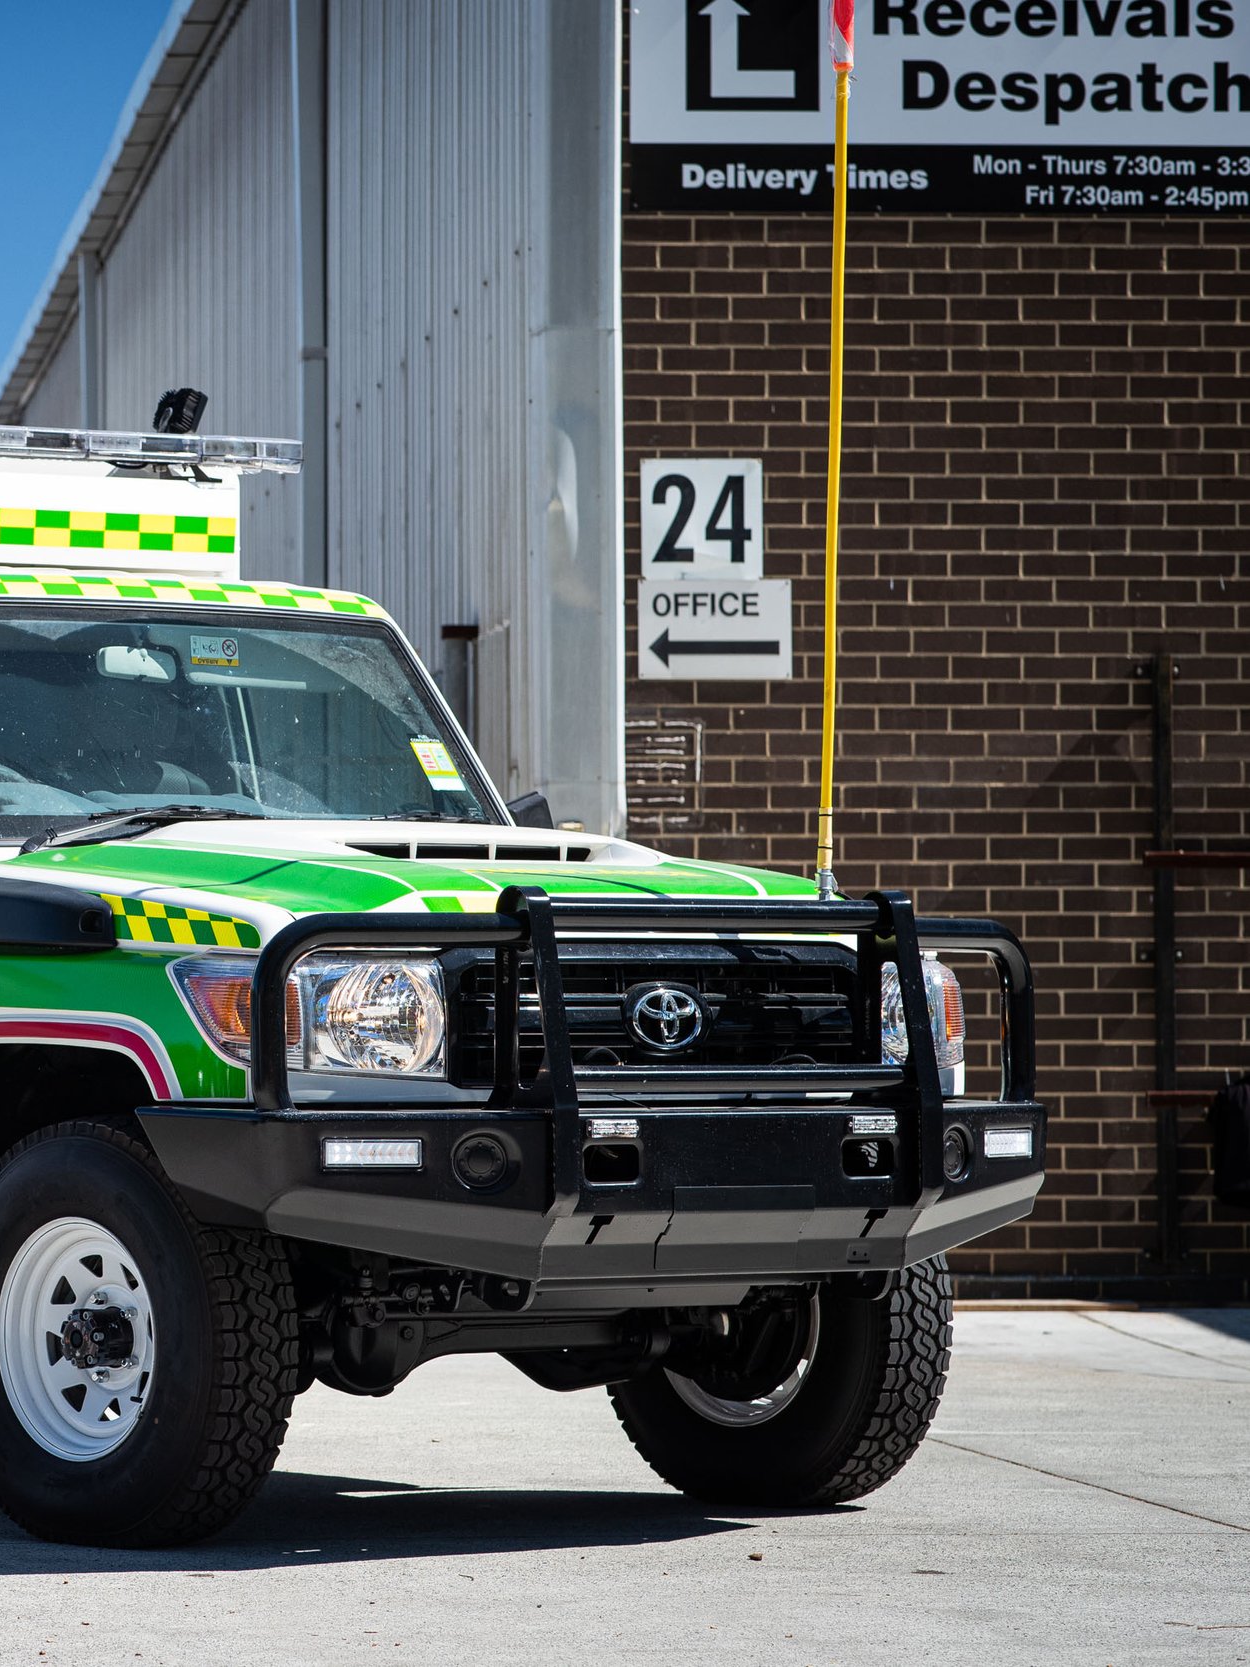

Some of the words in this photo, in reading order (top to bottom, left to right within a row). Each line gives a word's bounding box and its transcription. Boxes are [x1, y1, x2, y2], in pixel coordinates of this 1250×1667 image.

[873, 0, 1235, 38] Receivals
[902, 59, 1250, 125] Despatch
[682, 163, 818, 195] Delivery
[973, 155, 1021, 174] Mon
[1042, 155, 1107, 175] Thurs
[1113, 156, 1196, 175] 7:30am
[1025, 186, 1054, 205] Fri
[1060, 186, 1144, 206] 7:30am
[1165, 186, 1248, 210] 2:45pm
[652, 474, 752, 563] 24
[653, 592, 760, 618] OFFICE
